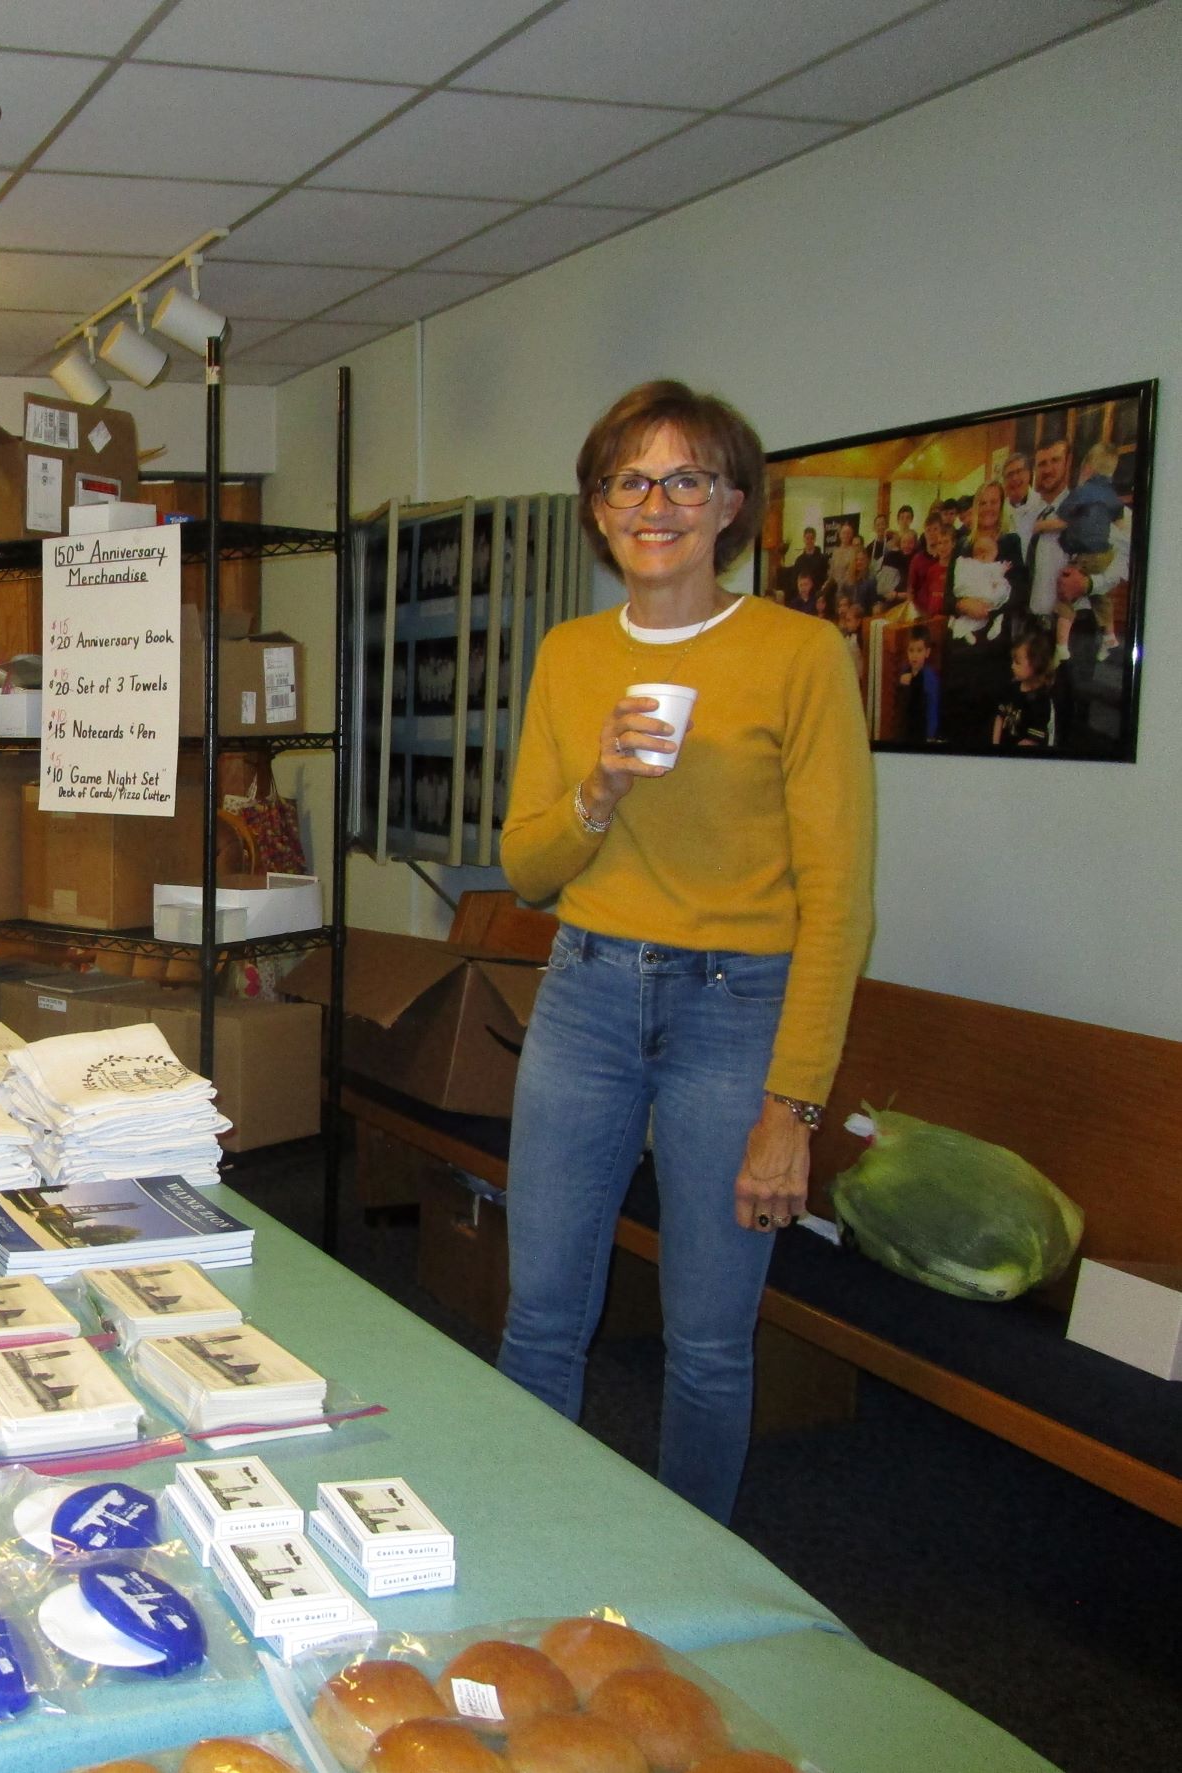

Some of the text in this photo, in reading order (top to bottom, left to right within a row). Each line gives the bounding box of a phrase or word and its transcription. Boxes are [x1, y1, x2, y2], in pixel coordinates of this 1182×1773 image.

[55, 540, 166, 566] 150th Anniversary
[68, 566, 147, 586] Merchandise
[76, 631, 139, 649] Anniversary
[145, 629, 174, 643] Book
[77, 677, 93, 694] Set
[99, 677, 111, 694] of
[117, 677, 124, 692] 3
[130, 674, 167, 692] Towels
[48, 721, 66, 739] $15
[73, 720, 124, 739] Notecards
[137, 723, 156, 739] Pen
[47, 766, 63, 783] $10
[107, 768, 137, 788] Night
[58, 786, 75, 798] Deck
[78, 787, 87, 798] of
[143, 787, 171, 802] Cutter
[166, 1183, 234, 1228] WAYNE ZION
[230, 1520, 290, 1532] Casino Quality
[376, 1546, 439, 1557] Casino Quality
[383, 1571, 441, 1585] Casino Quality
[270, 1611, 338, 1625] Casino Quality
